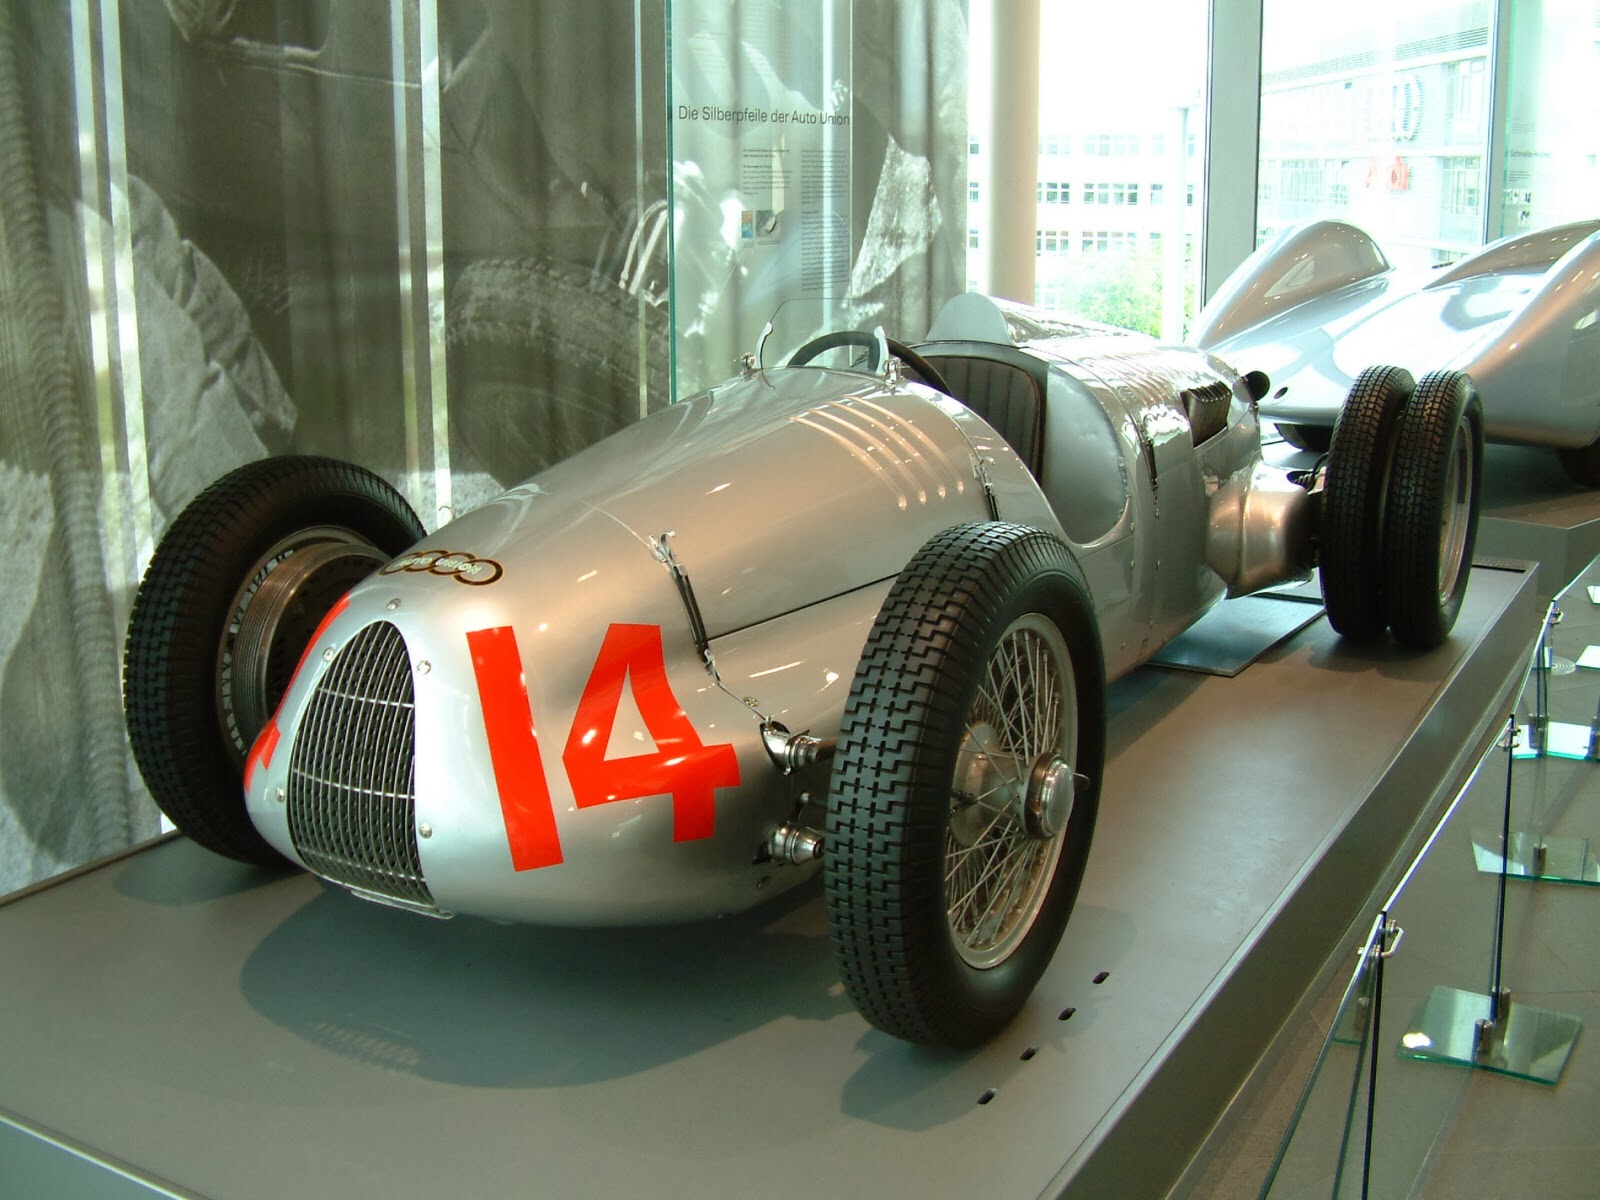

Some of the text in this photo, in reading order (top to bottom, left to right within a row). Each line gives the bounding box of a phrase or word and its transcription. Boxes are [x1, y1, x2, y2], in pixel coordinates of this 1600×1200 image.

[679, 106, 850, 126] Die Silberpfeile der Auto Union
[394, 557, 482, 575] AUTO UNION
[466, 623, 741, 872] 14
